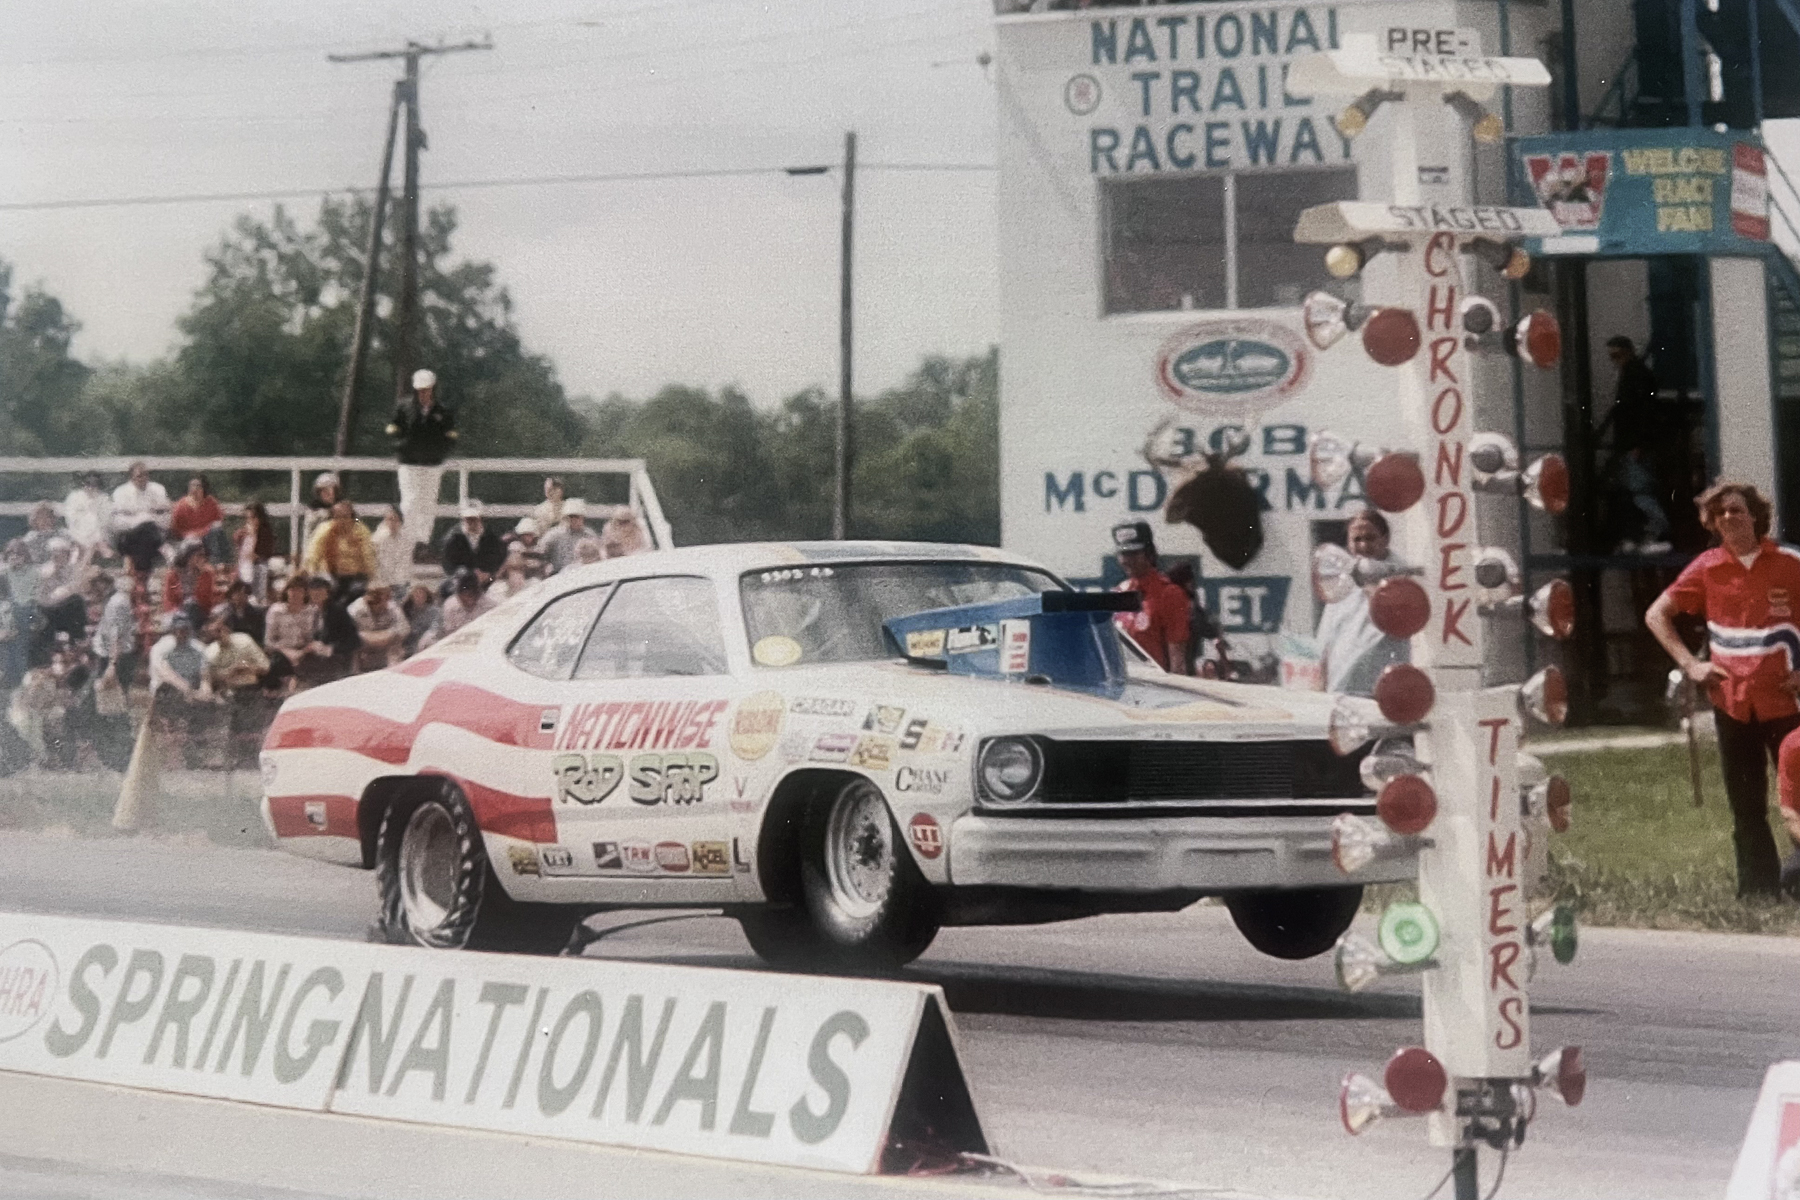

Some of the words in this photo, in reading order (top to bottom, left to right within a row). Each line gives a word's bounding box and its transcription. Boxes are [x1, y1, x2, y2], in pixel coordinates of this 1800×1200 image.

[1387, 28, 1469, 55] PRE-
[1090, 115, 1352, 173] RACEWAY
[1389, 206, 1524, 230] STAGED
[1424, 231, 1472, 647] CHRONDEK
[1478, 718, 1522, 1050] TIMERS
[0, 966, 48, 1016] HRA
